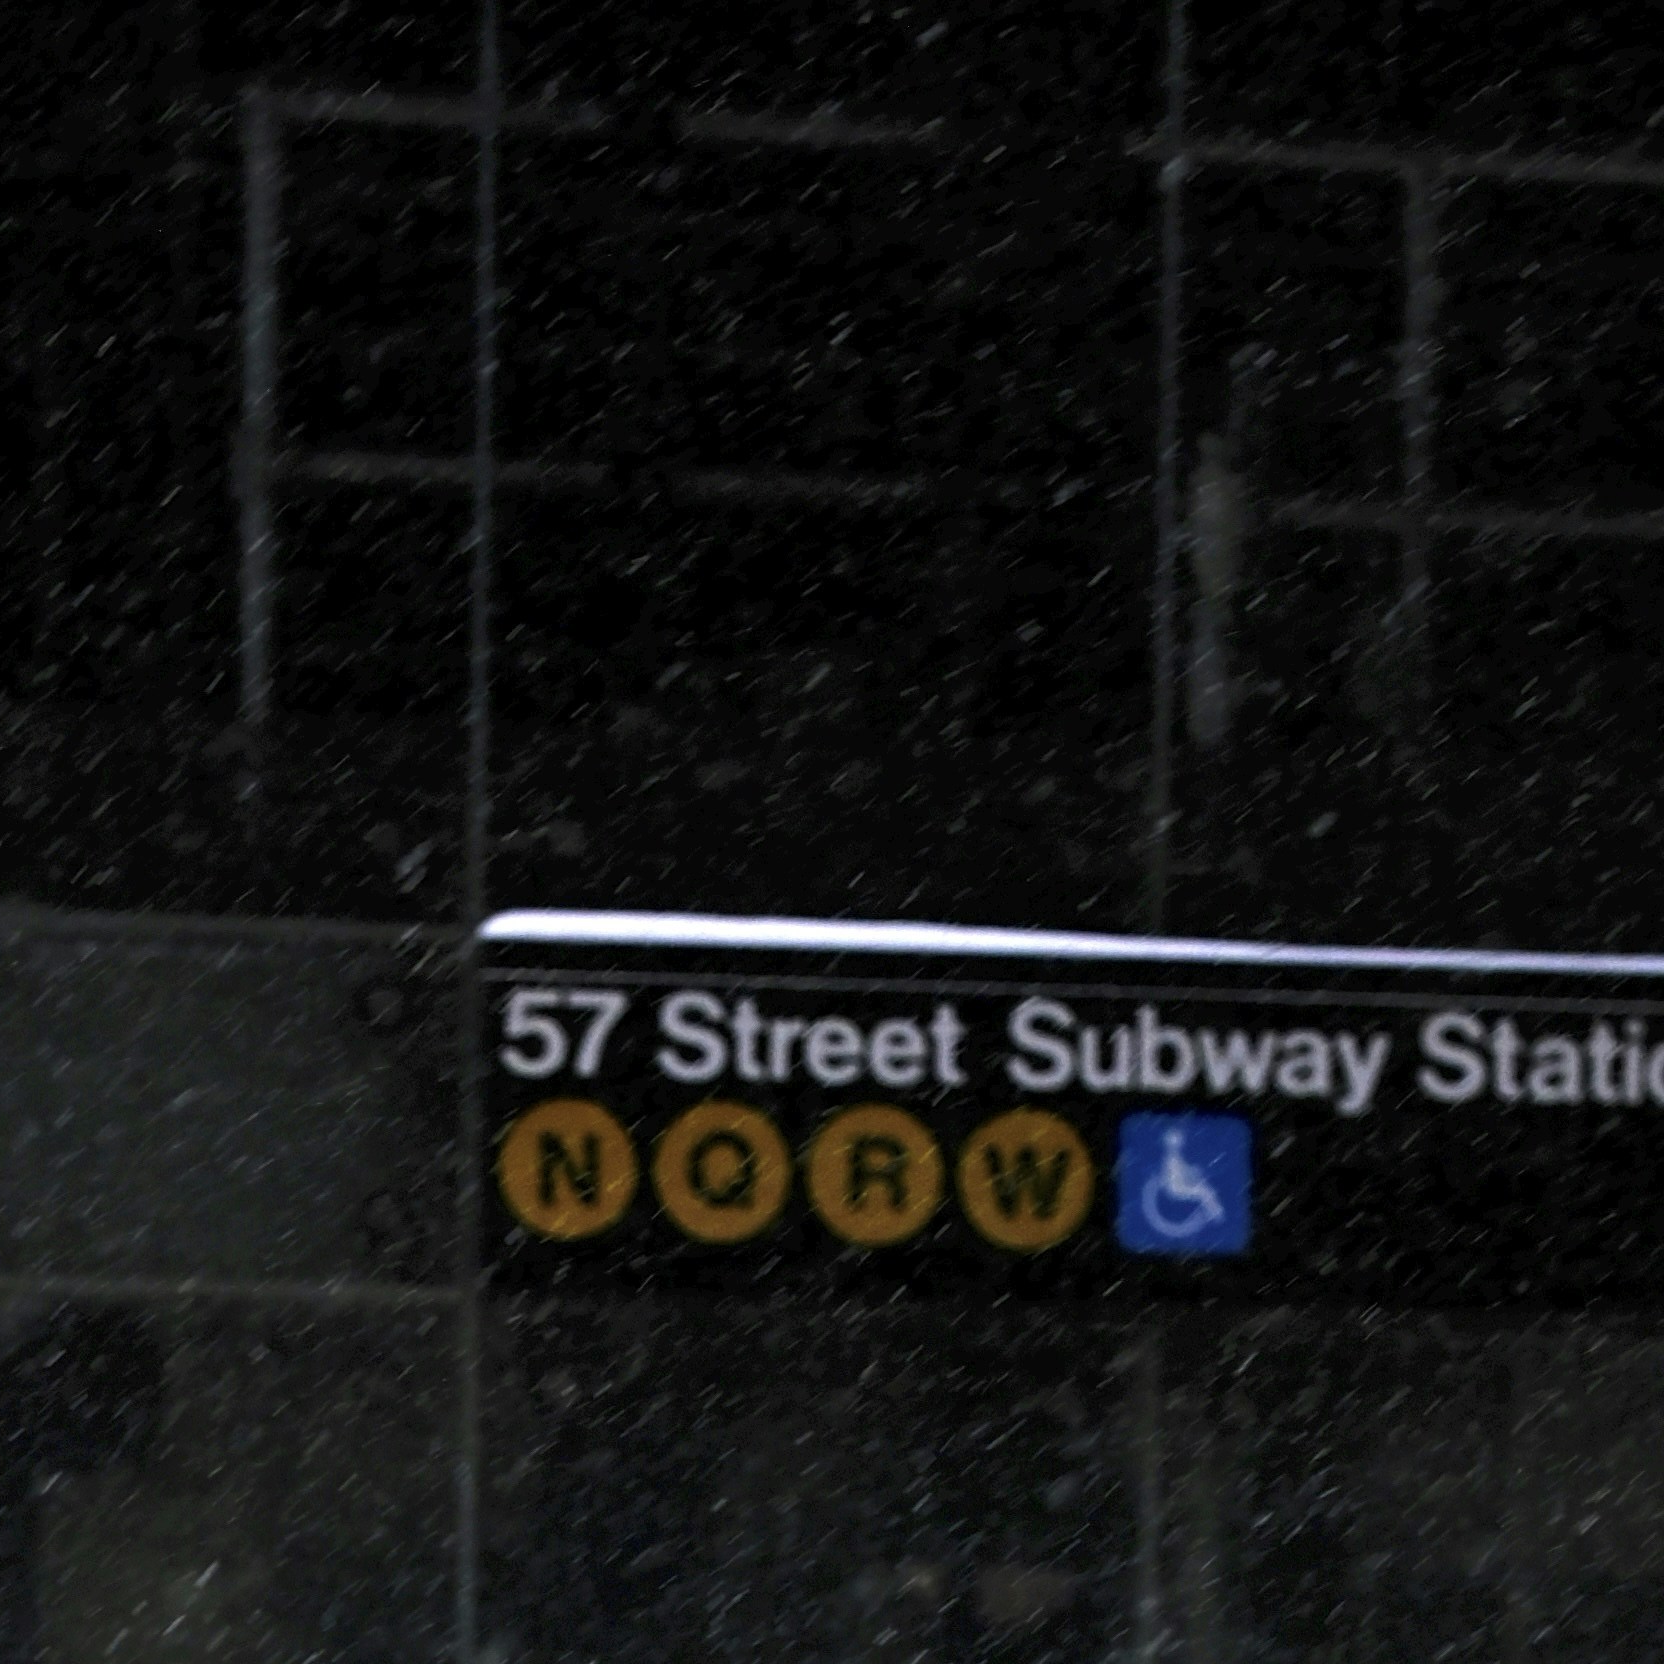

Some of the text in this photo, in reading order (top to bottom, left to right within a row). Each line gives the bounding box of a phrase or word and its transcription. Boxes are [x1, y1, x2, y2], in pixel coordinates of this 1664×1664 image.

[501, 990, 628, 1078] 57
[656, 993, 966, 1084] Street
[1008, 998, 1390, 1116] Subway
[540, 1130, 1068, 1220] N Q R W
